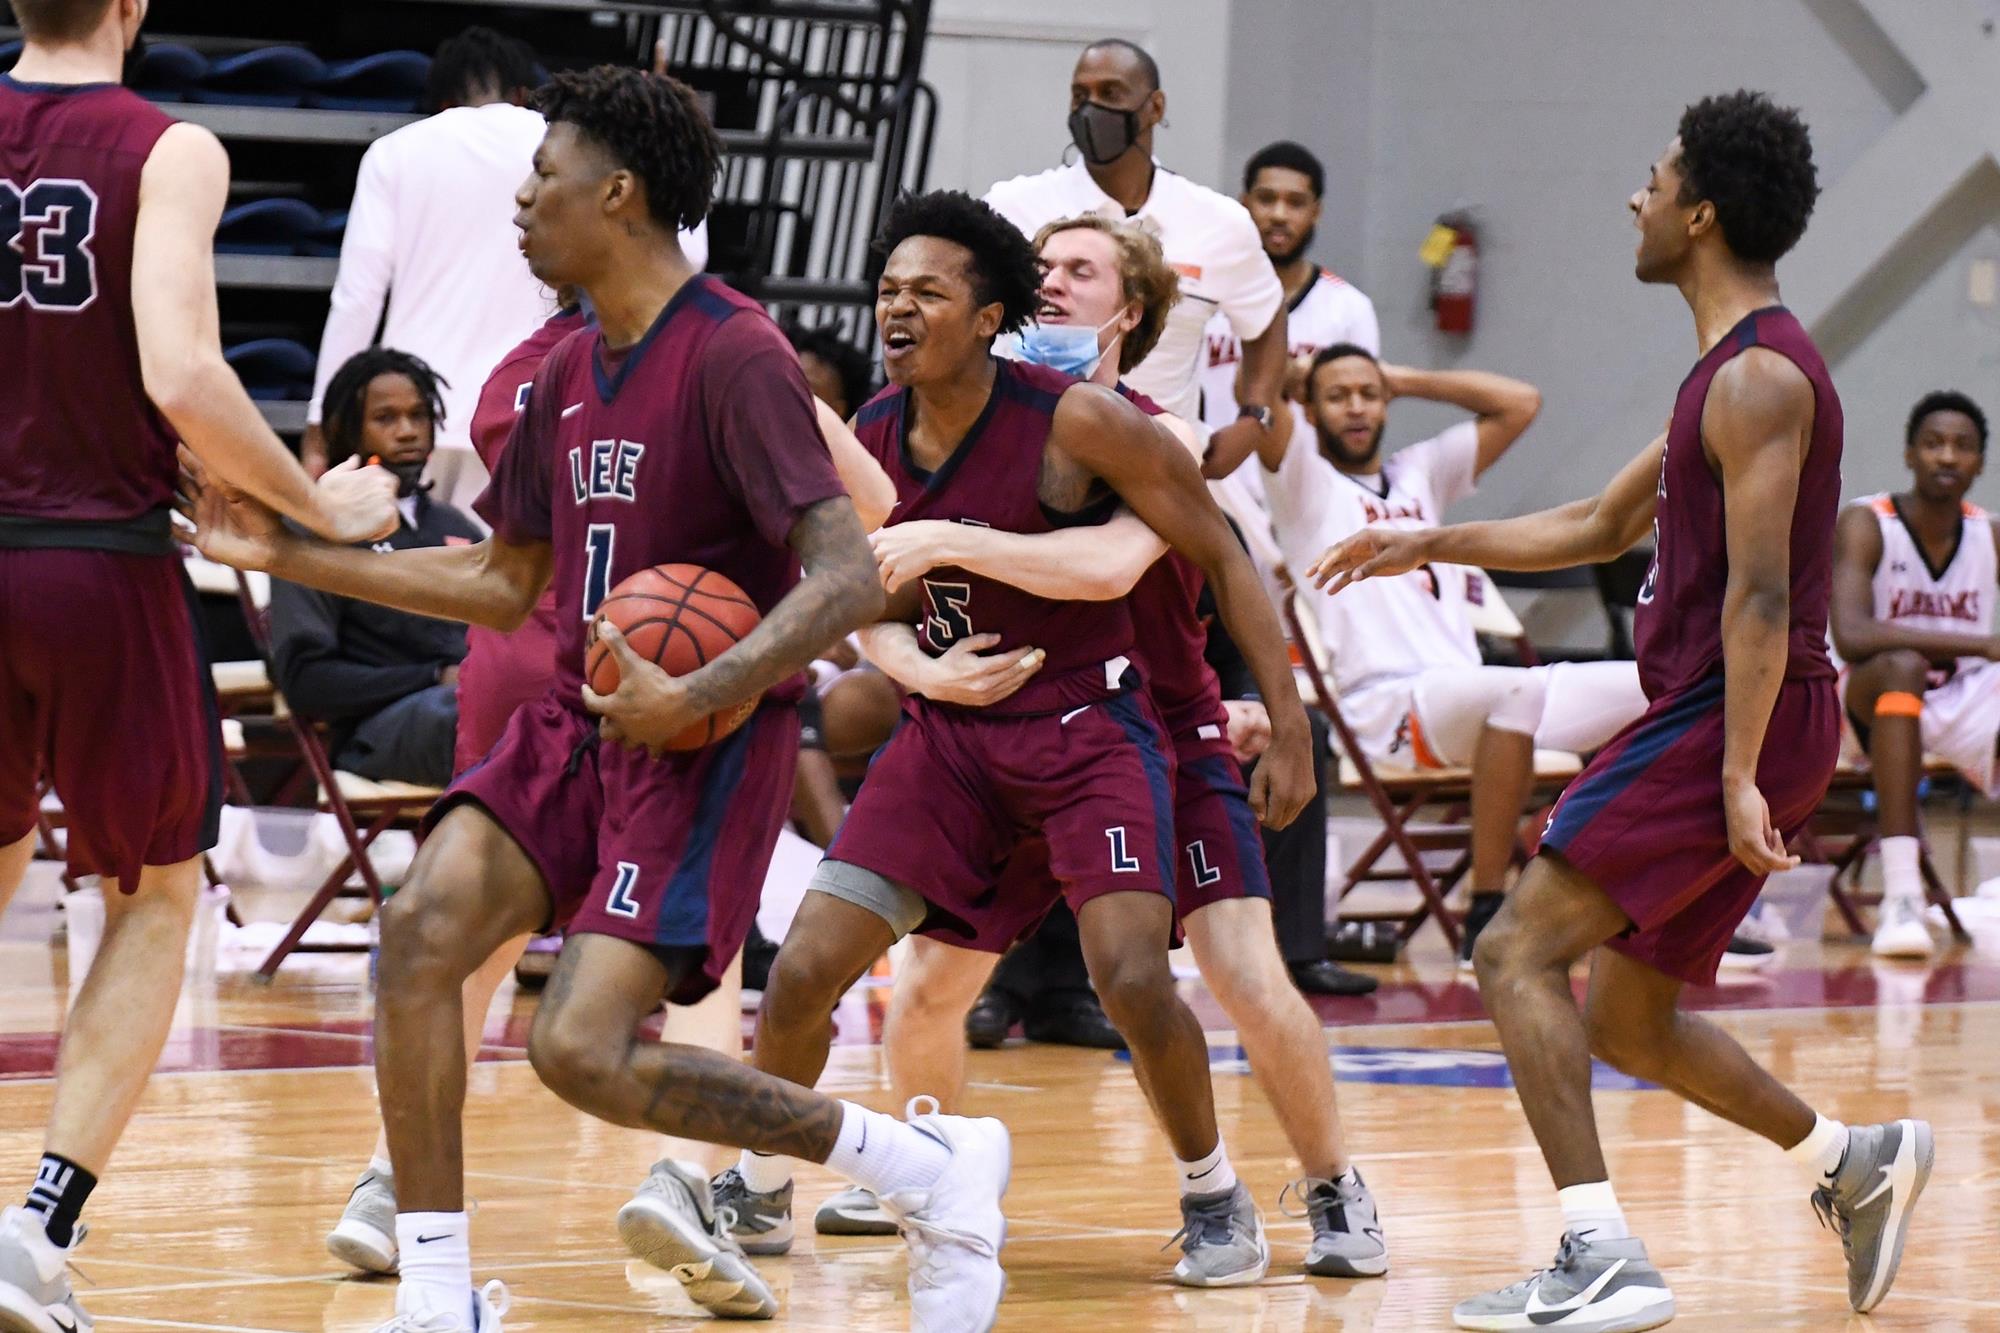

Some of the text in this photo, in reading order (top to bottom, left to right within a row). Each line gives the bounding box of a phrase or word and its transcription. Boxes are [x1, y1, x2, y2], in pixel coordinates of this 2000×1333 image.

[569, 438, 645, 505] LEE
[583, 523, 615, 622] 1
[923, 578, 974, 651] 5
[1105, 826, 1140, 873] L
[1186, 839, 1221, 888] L
[605, 860, 640, 919] L
